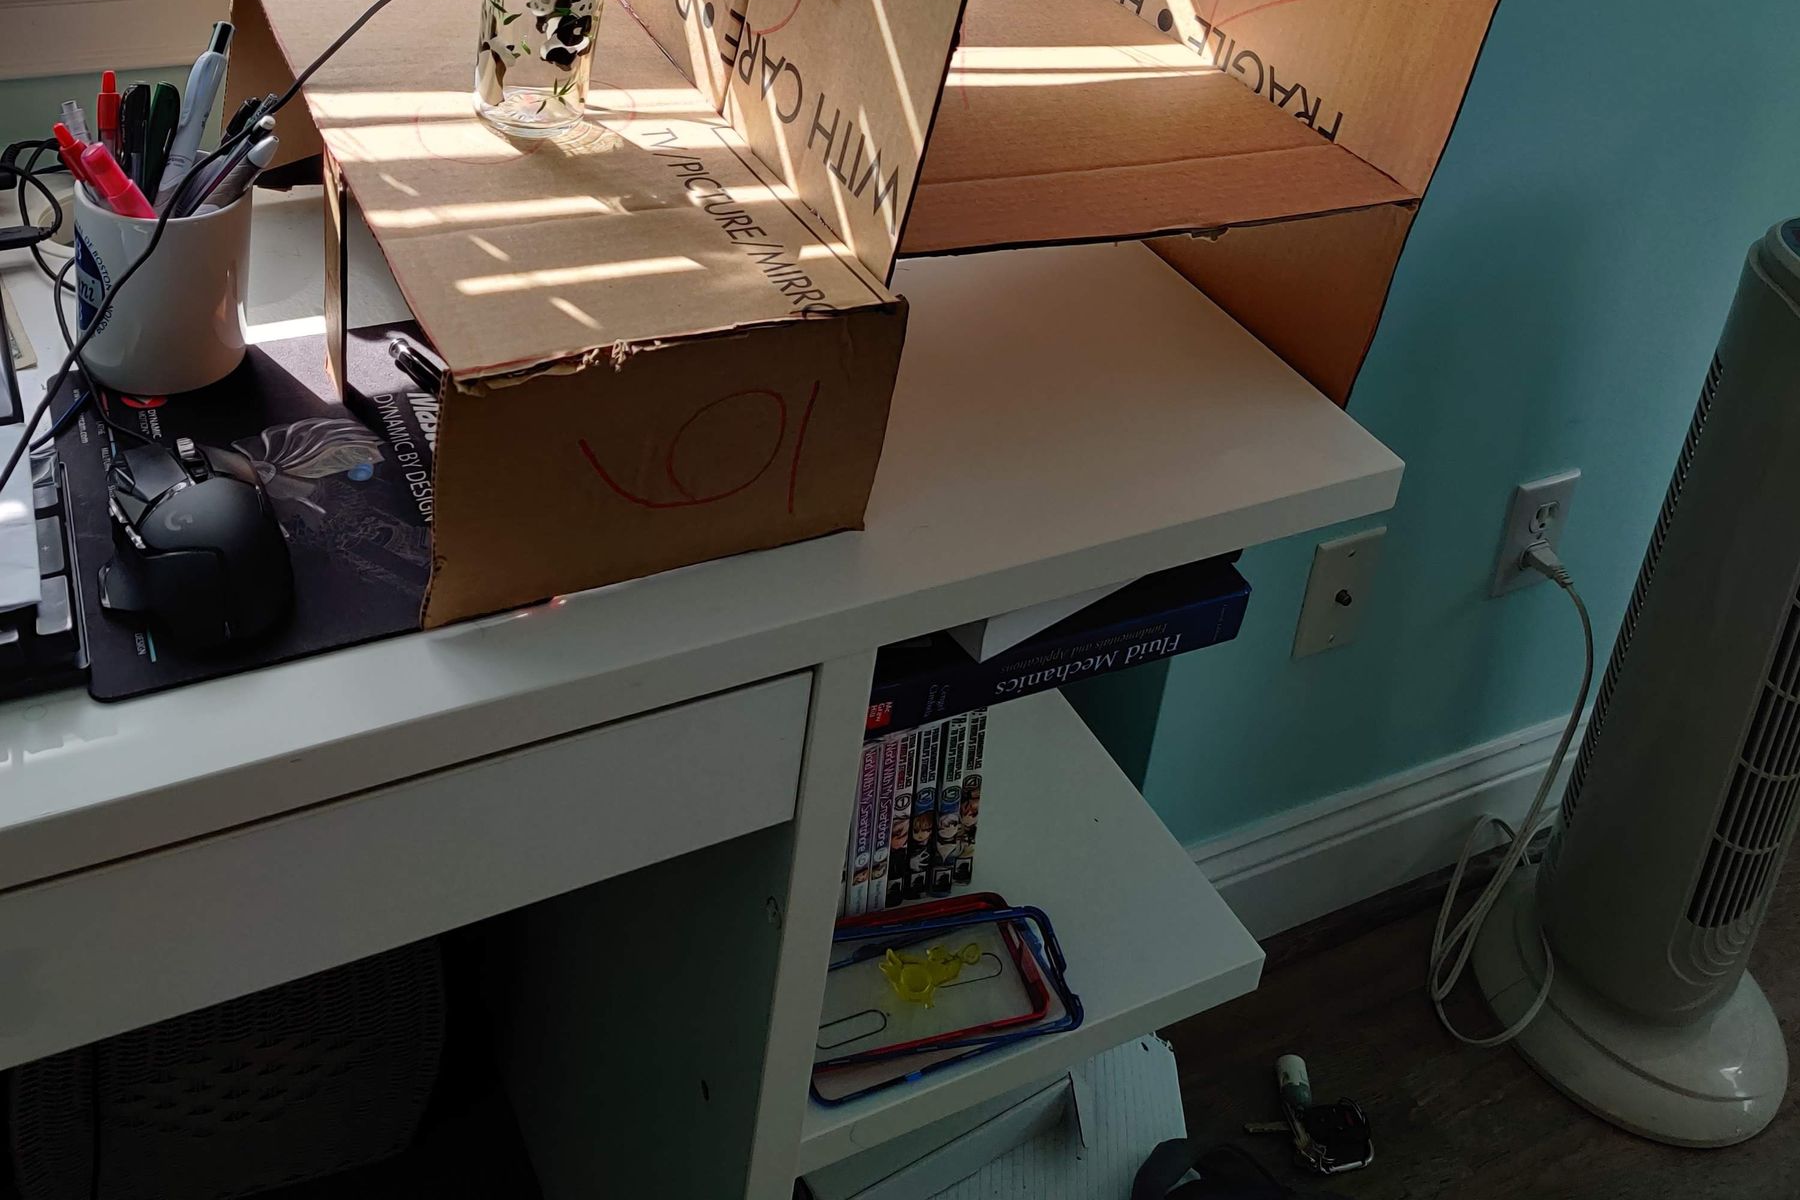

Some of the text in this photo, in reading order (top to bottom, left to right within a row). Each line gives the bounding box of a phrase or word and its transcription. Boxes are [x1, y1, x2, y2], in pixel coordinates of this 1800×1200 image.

[720, 7, 899, 236] WITH CARE
[147, 409, 163, 440] DYNAMIC
[373, 393, 434, 523] DYNAMIC BY DESIGN
[134, 631, 147, 656] DESIGN
[994, 632, 1182, 695] Fluid Mechanics
